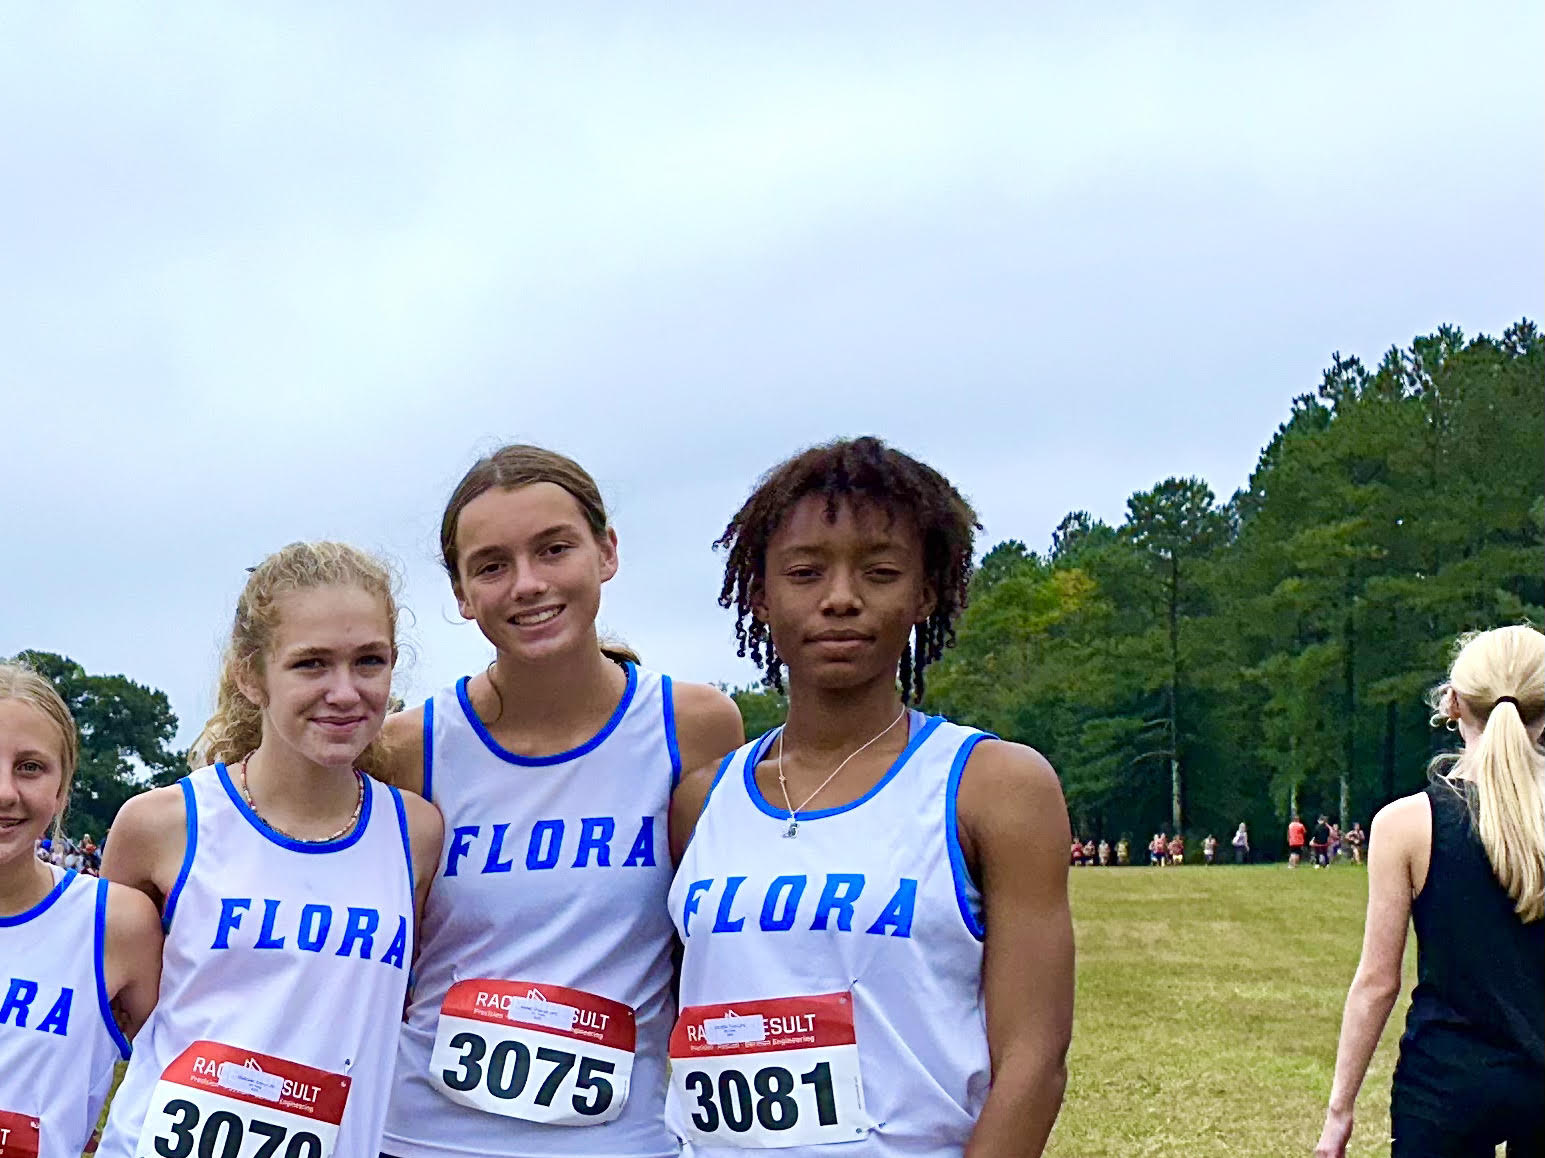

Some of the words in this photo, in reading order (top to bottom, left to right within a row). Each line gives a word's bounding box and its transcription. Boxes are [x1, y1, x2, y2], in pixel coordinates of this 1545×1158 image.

[443, 816, 659, 879] FLORA
[209, 897, 407, 971] FLORA
[682, 873, 919, 939] FLORA
[475, 992, 510, 1011] RAC
[572, 1009, 610, 1031] SULT
[763, 1013, 816, 1037] ESULT
[281, 1079, 322, 1104] SULT
[442, 1032, 616, 1116] 3075
[685, 1061, 838, 1133] 3081
